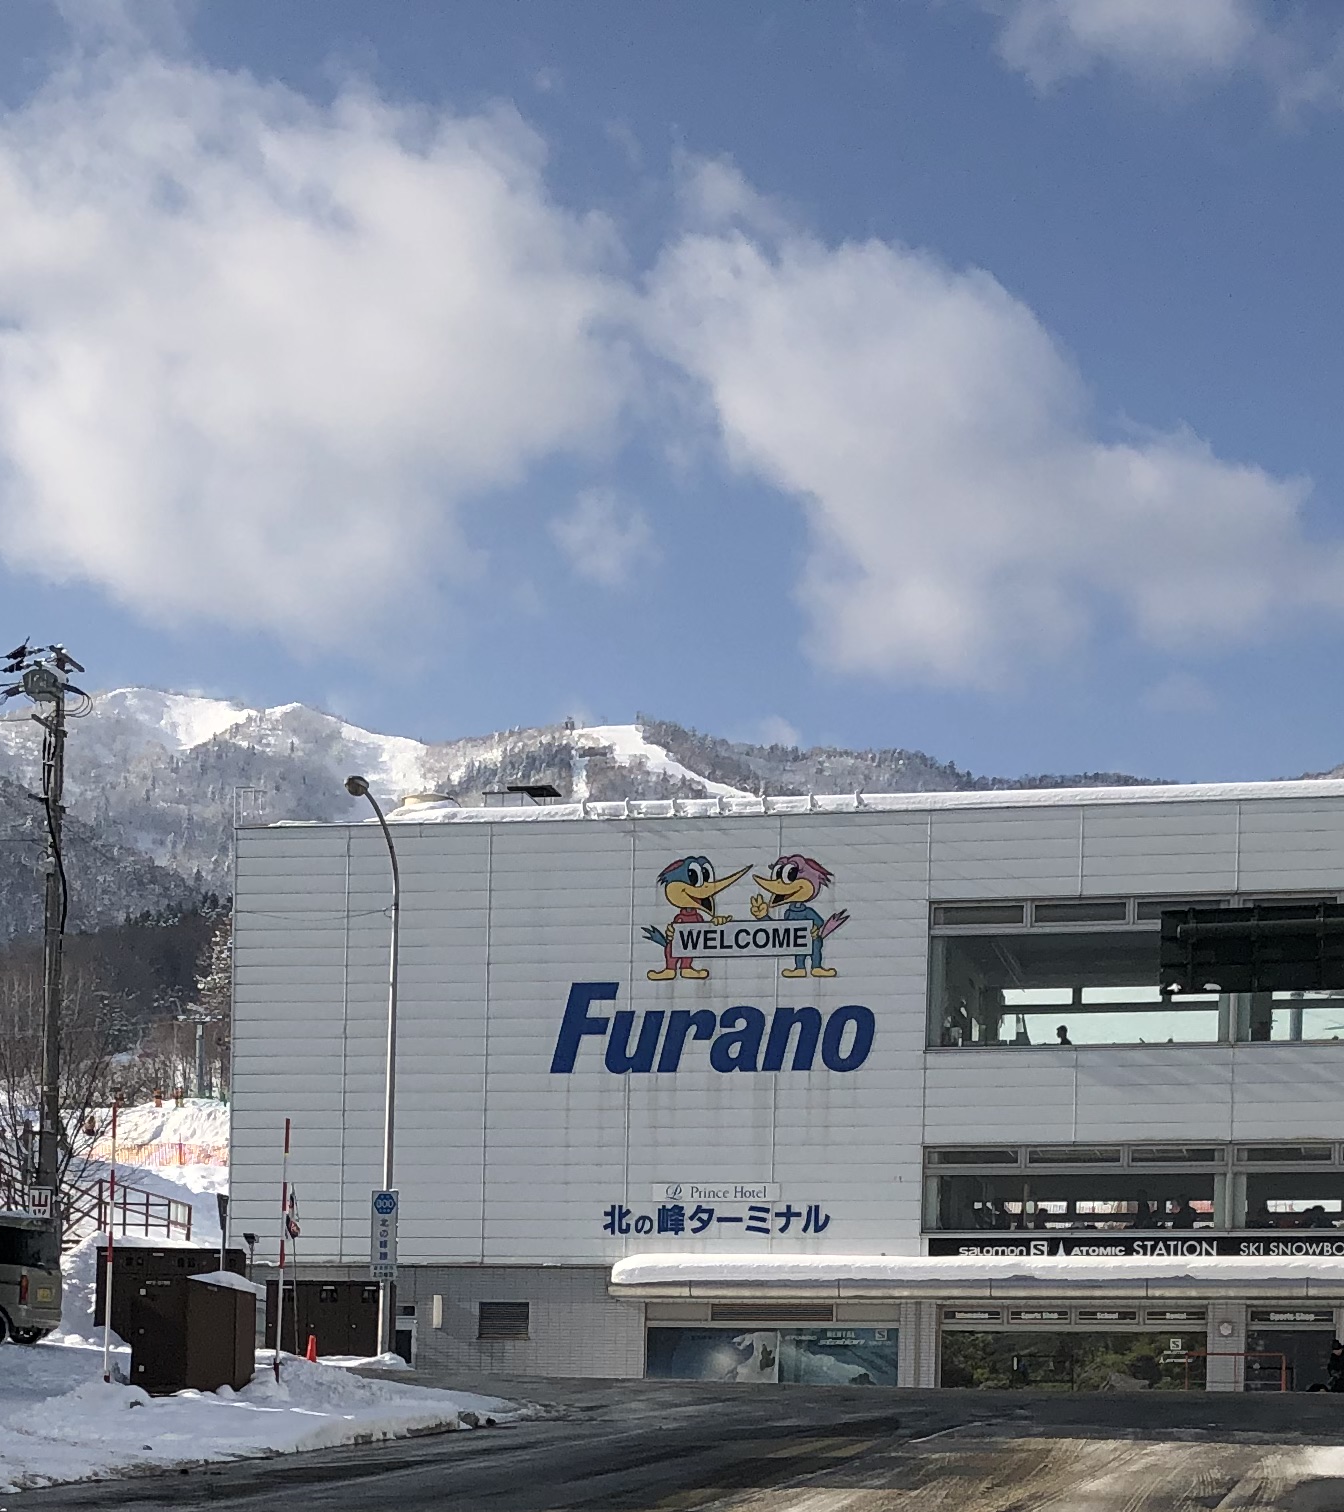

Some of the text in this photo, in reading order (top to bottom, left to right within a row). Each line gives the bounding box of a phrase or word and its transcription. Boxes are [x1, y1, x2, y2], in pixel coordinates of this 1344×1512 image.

[678, 926, 808, 950] WELCOME
[549, 981, 876, 1075] Furano
[690, 1185, 768, 1199] Prince Hotel
[602, 1204, 831, 1236] 北の峰ターミナル
[958, 1246, 1027, 1256] salomon
[1070, 1246, 1126, 1256] ATOMIC
[1132, 1240, 1217, 1257] STATION
[1239, 1242, 1264, 1256] SKI
